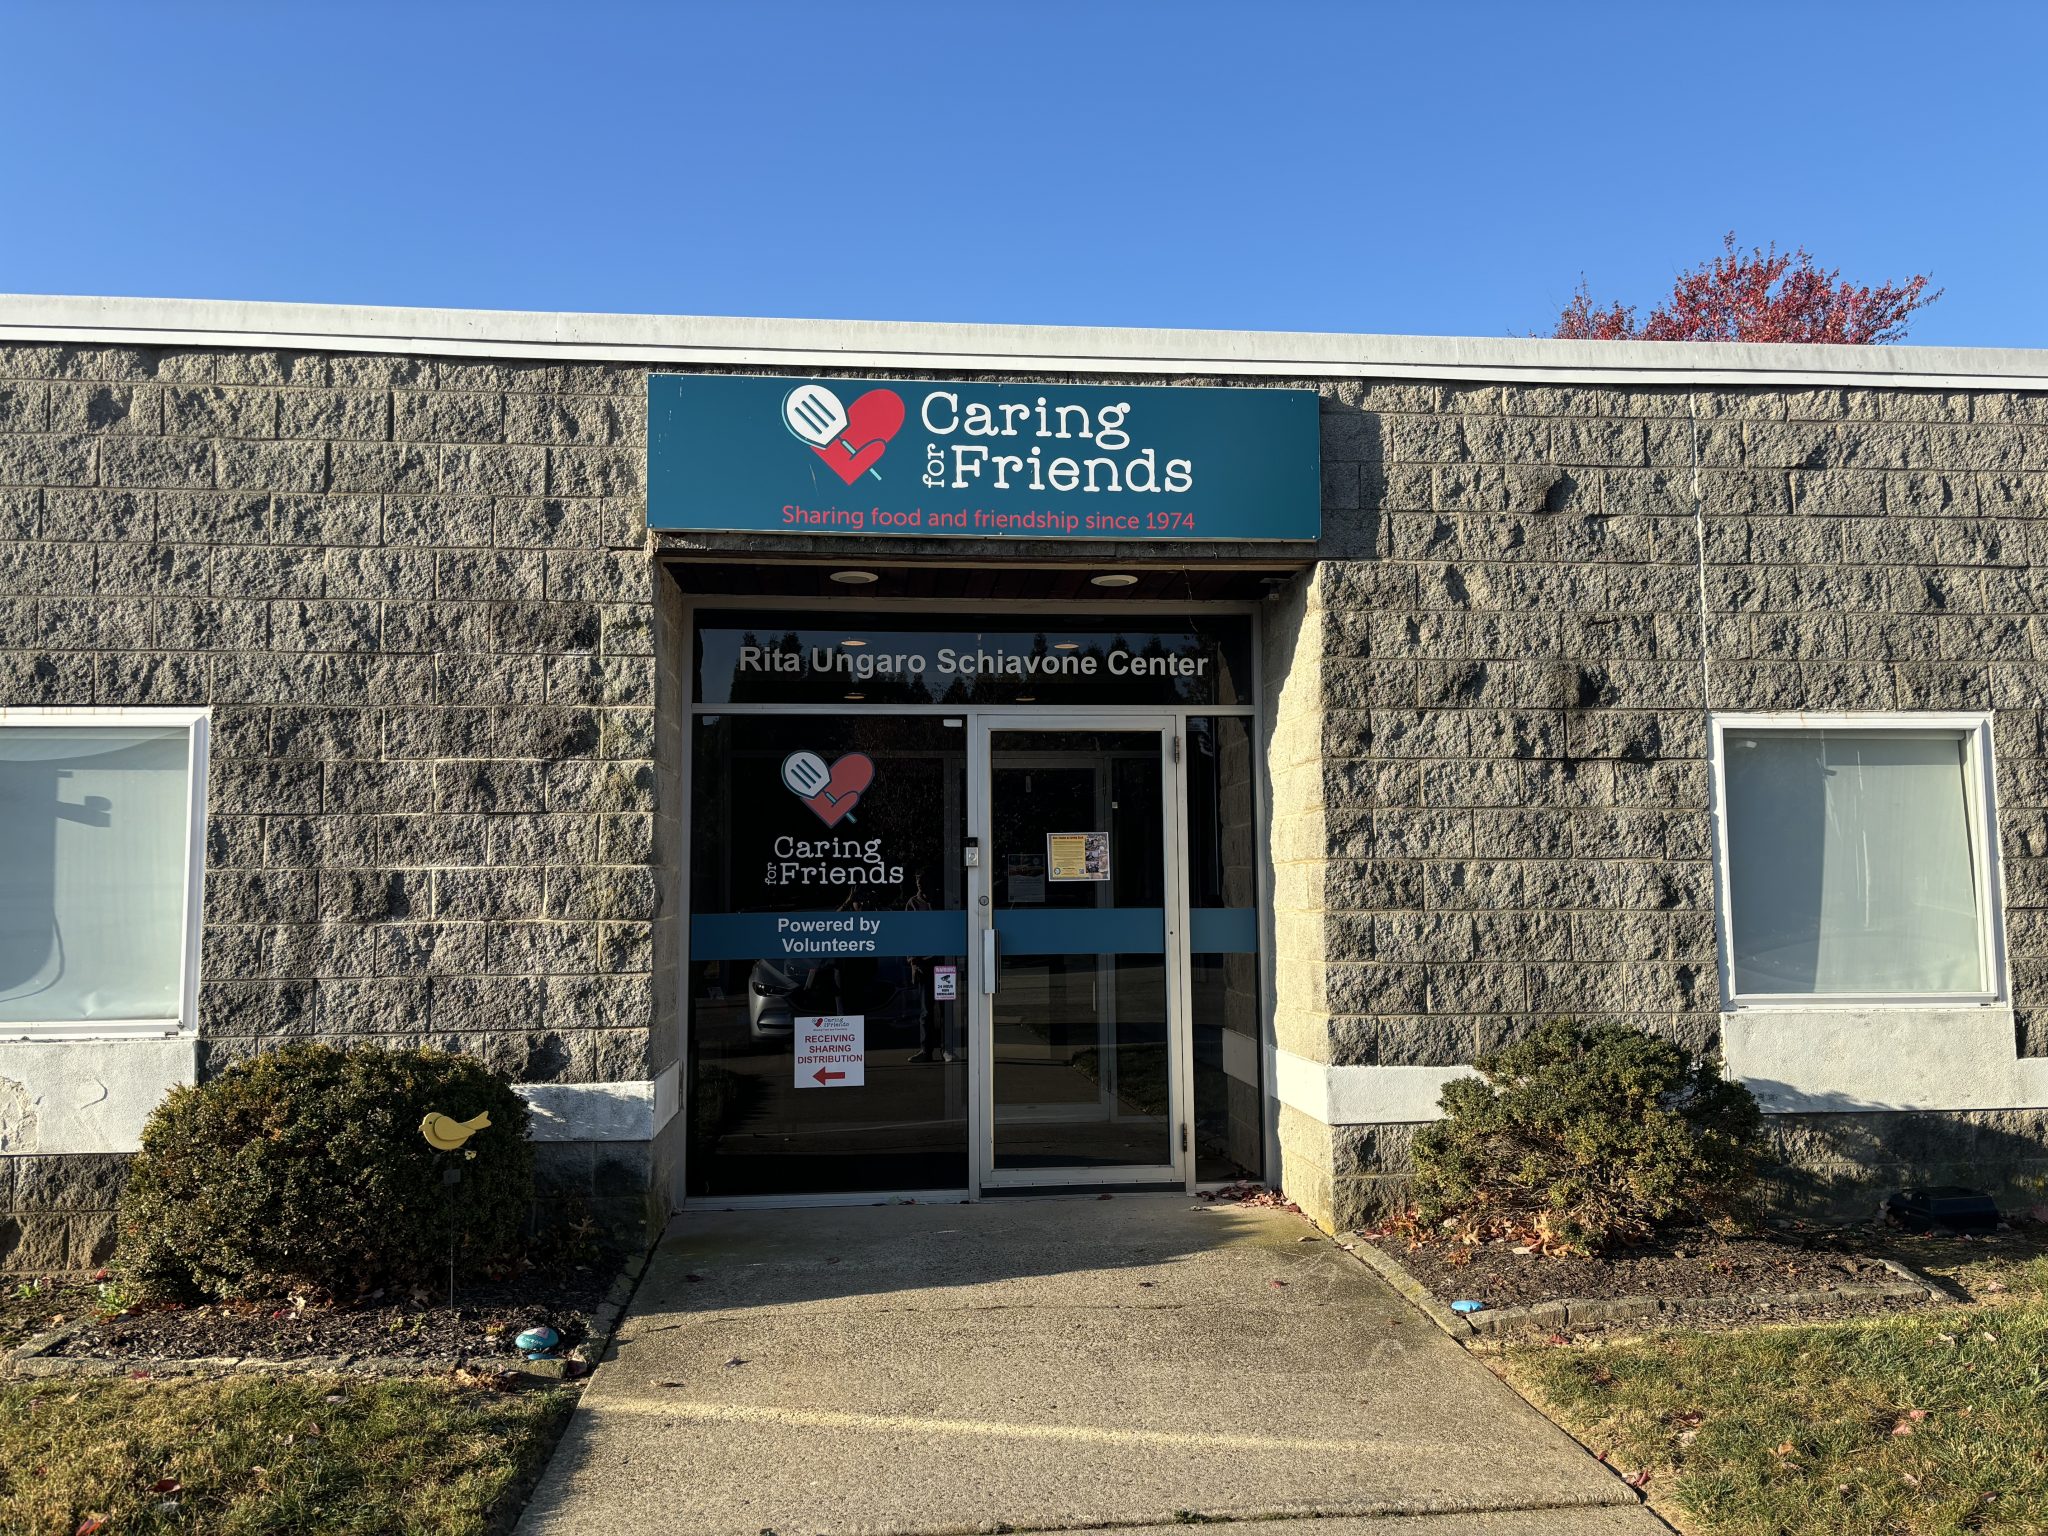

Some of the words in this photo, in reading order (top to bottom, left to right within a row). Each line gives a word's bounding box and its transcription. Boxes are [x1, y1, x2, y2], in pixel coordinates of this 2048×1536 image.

[921, 391, 1131, 450] Caring
[922, 443, 945, 489] for
[951, 448, 1193, 493] Friends
[782, 504, 865, 530] Sharing
[870, 507, 922, 527] food
[927, 510, 968, 528] and
[973, 509, 1080, 533] friendship
[1085, 511, 1140, 530] since
[1146, 511, 1195, 531] 1974
[739, 646, 801, 672] Rita
[812, 647, 927, 679] Ungaro
[936, 648, 1098, 675] Schiavone
[1107, 650, 1209, 676] Center
[774, 835, 882, 864] Caring
[764, 862, 777, 886] for
[779, 861, 904, 885] Friends
[777, 917, 854, 933] Powered
[859, 917, 881, 935] by
[781, 937, 876, 953] Volunteers
[804, 1033, 856, 1044] RECEIVING
[809, 1044, 852, 1054] SHARING
[797, 1054, 863, 1065] DISTRIBUTION
